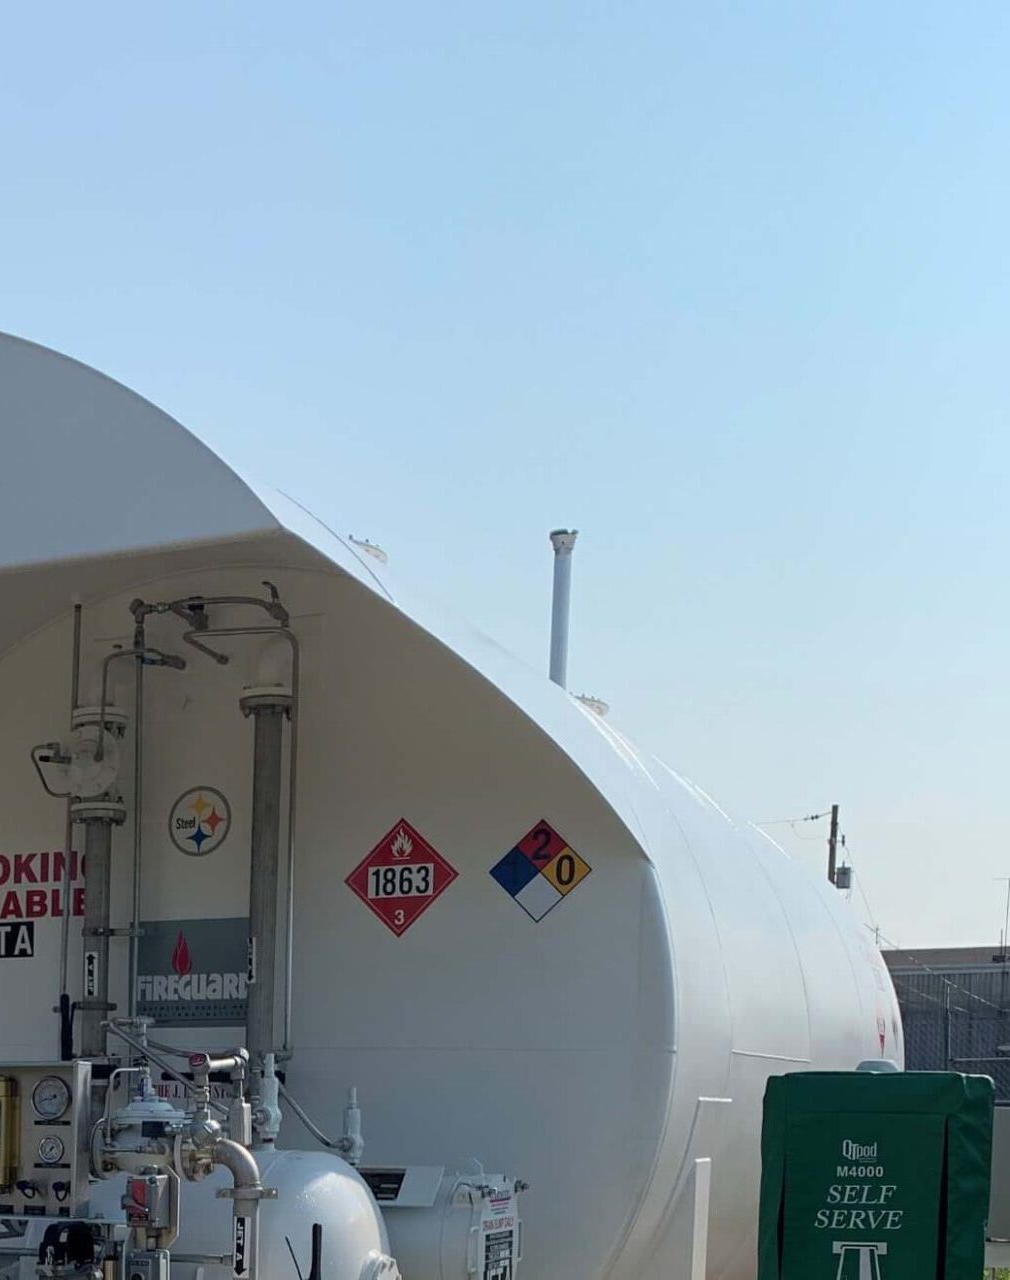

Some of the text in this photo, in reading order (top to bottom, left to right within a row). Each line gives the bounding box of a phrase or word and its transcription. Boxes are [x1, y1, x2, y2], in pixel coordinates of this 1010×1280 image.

[175, 816, 196, 830] Steel
[531, 828, 551, 860] 2
[555, 854, 576, 886] 0
[371, 865, 430, 897] 1863
[394, 909, 405, 926] 3
[13, 924, 32, 956] A
[836, 1166, 884, 1178] M4000
[826, 1185, 897, 1205] SELF
[814, 1210, 903, 1230] SERVE
